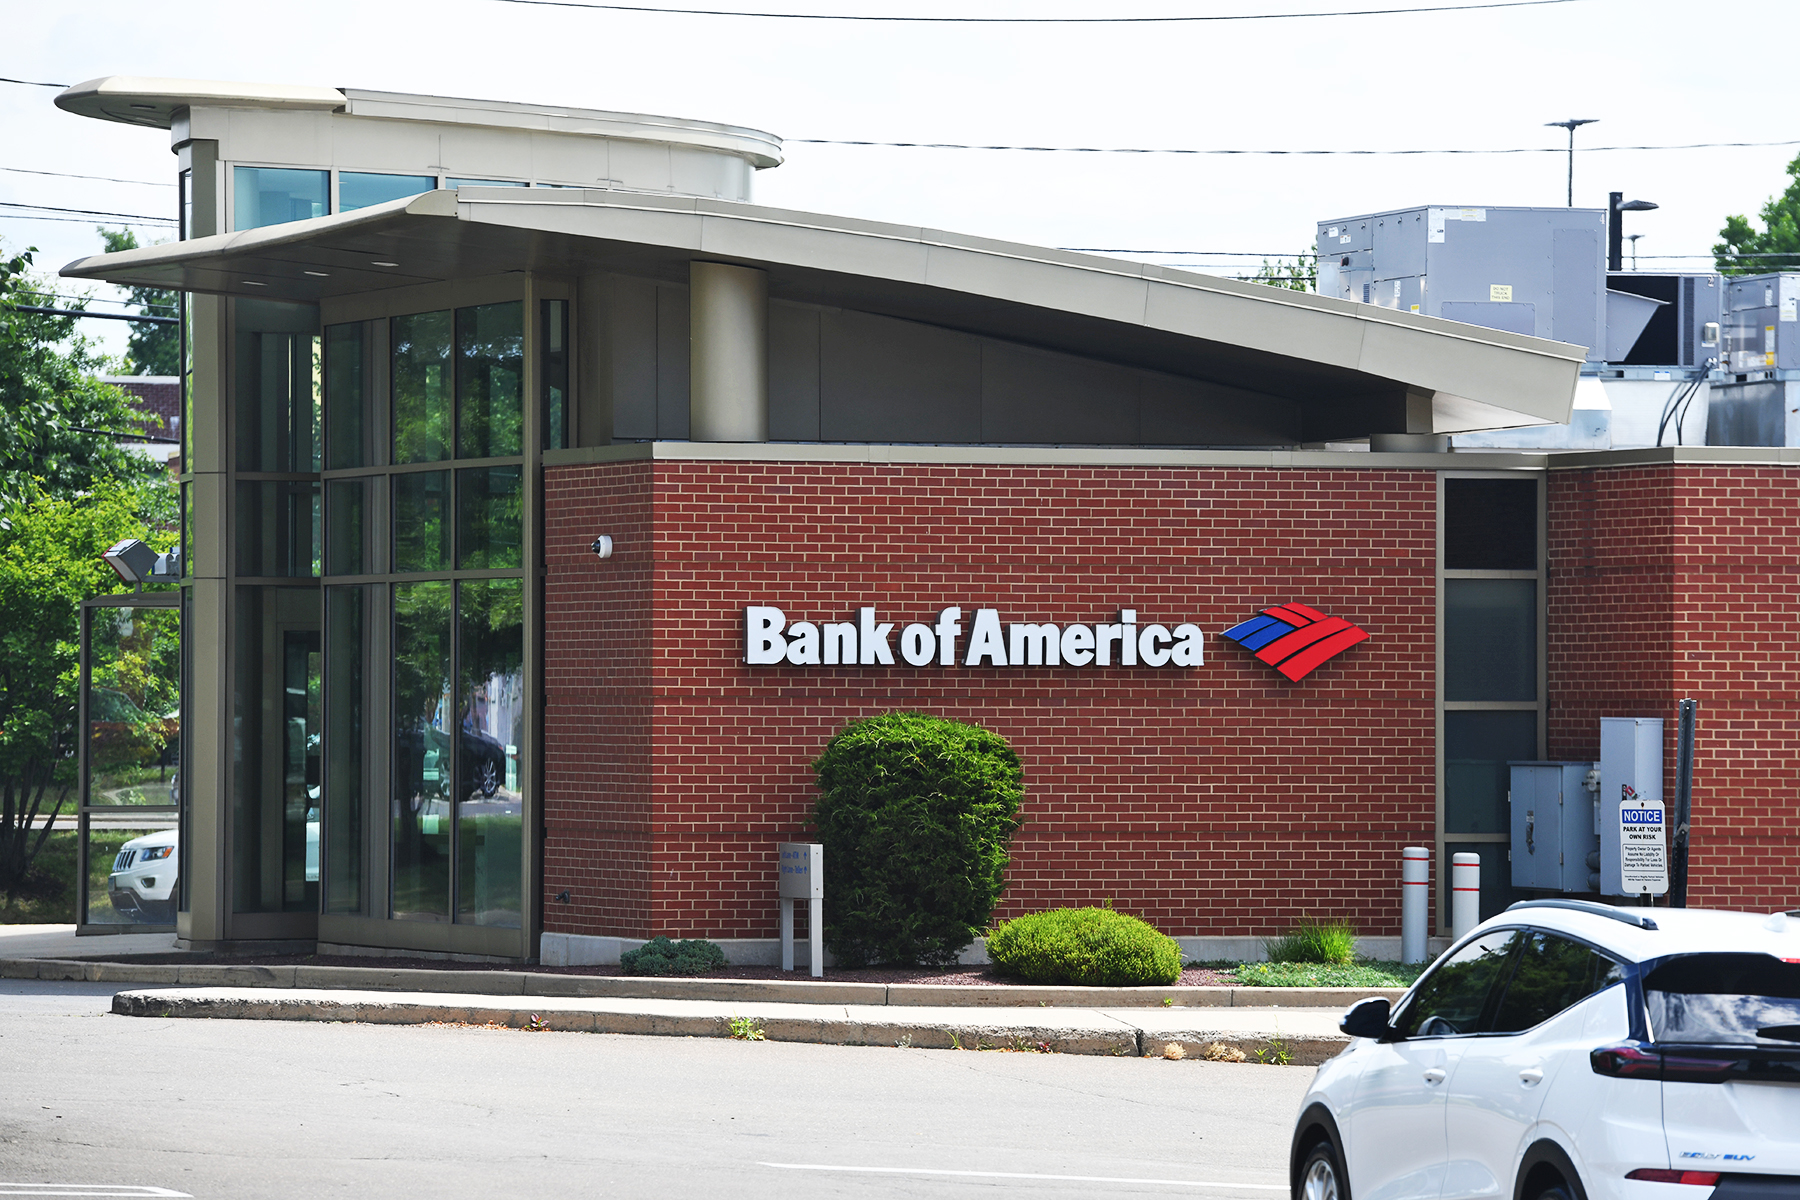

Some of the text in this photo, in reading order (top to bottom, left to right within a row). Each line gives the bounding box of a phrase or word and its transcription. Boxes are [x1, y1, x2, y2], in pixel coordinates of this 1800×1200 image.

[746, 606, 1205, 667] Bank of America
[1624, 811, 1660, 821] NOTICE
